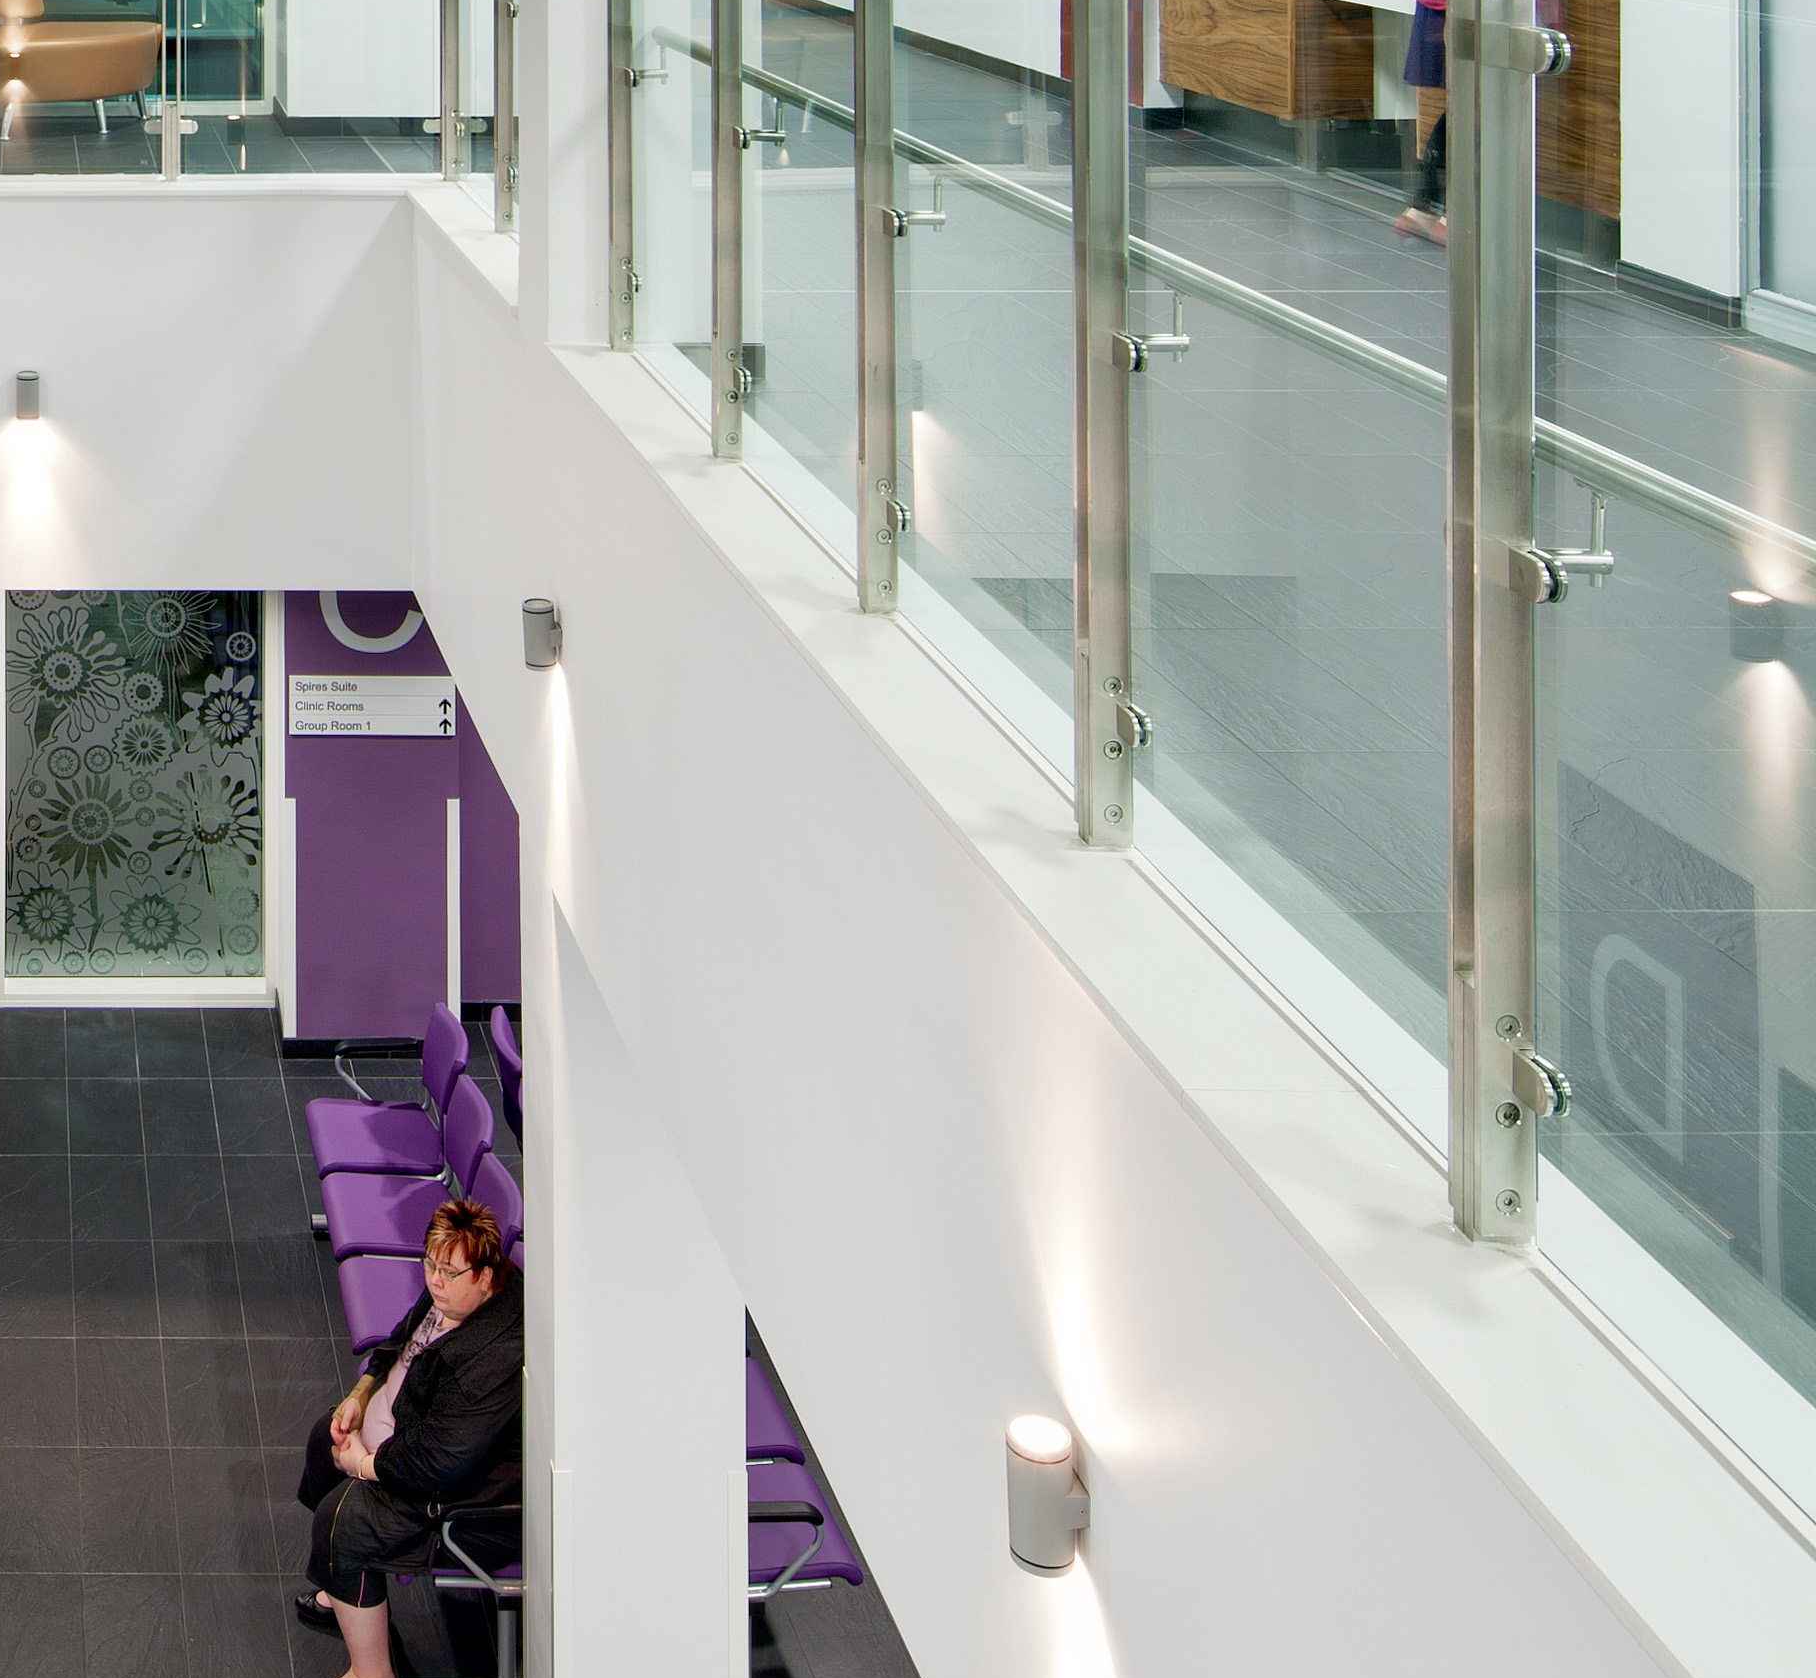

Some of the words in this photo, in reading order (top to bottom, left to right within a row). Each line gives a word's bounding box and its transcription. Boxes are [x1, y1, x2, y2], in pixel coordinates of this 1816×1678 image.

[295, 681, 328, 693] Spires
[330, 681, 358, 692] Suite
[295, 701, 324, 711] Clinic
[327, 701, 365, 711] Rooms
[295, 720, 328, 732] Group
[331, 720, 363, 731] Room
[366, 721, 371, 731] 1
